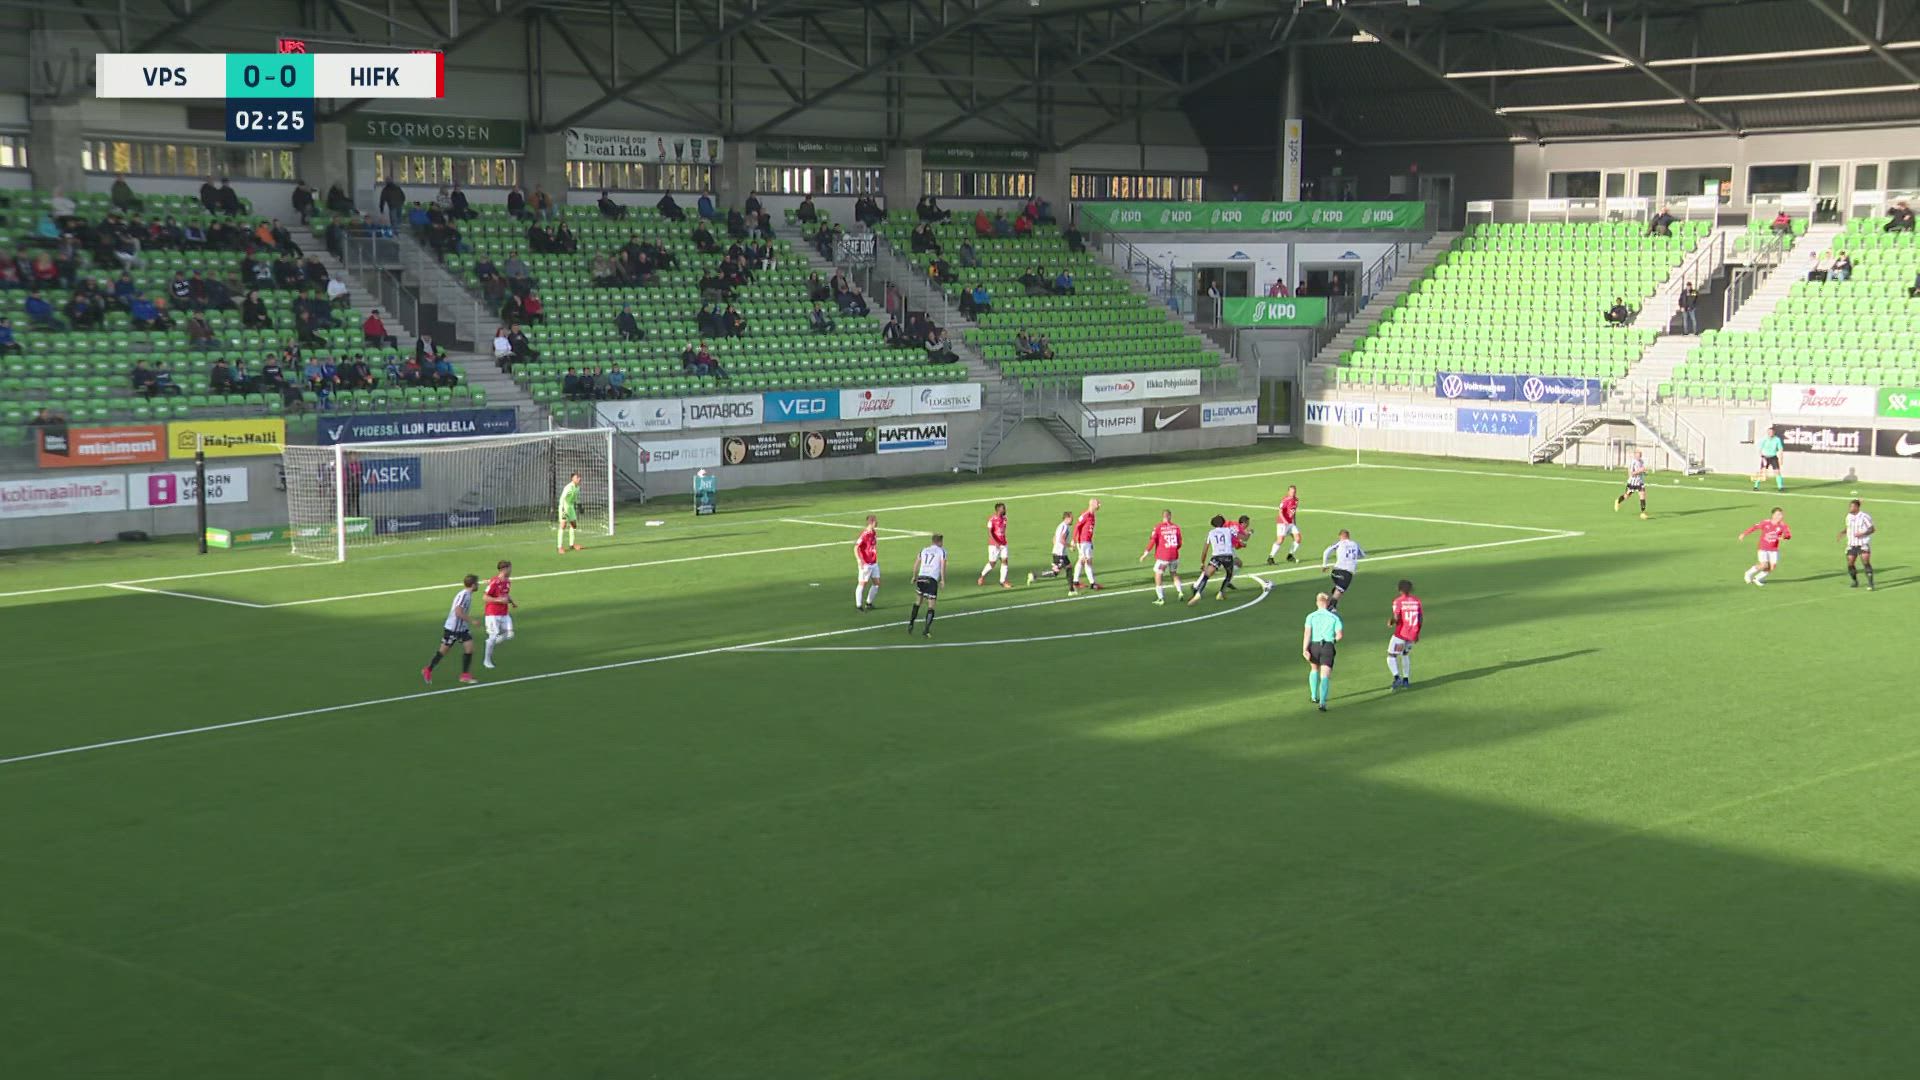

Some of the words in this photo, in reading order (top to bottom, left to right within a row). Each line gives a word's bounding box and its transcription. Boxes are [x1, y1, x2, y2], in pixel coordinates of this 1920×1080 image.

[367, 120, 490, 141] STORMOSSEN
[584, 133, 630, 144] Supporting
[619, 145, 647, 157] kids
[1121, 210, 1142, 222] KPO
[1171, 211, 1192, 222] KPO
[1222, 211, 1242, 222] KPO
[1272, 211, 1293, 222] KPO
[1322, 211, 1343, 222] KPO
[1373, 211, 1394, 222] KPO
[1268, 303, 1296, 319] KPO
[1463, 382, 1506, 393] Volkswagen
[690, 402, 754, 420] DATABROS
[778, 398, 826, 416] VEO
[1212, 405, 1256, 418] LEINOLAT
[1307, 404, 1331, 421] NYT
[352, 422, 400, 438] YHDESSÄ
[402, 422, 425, 435] ILON
[426, 420, 476, 434] PUOLELLA
[878, 425, 947, 441] HARTMAN
[653, 450, 680, 462] SOP
[181, 474, 231, 486] VASAN
[924, 553, 935, 564] 17
